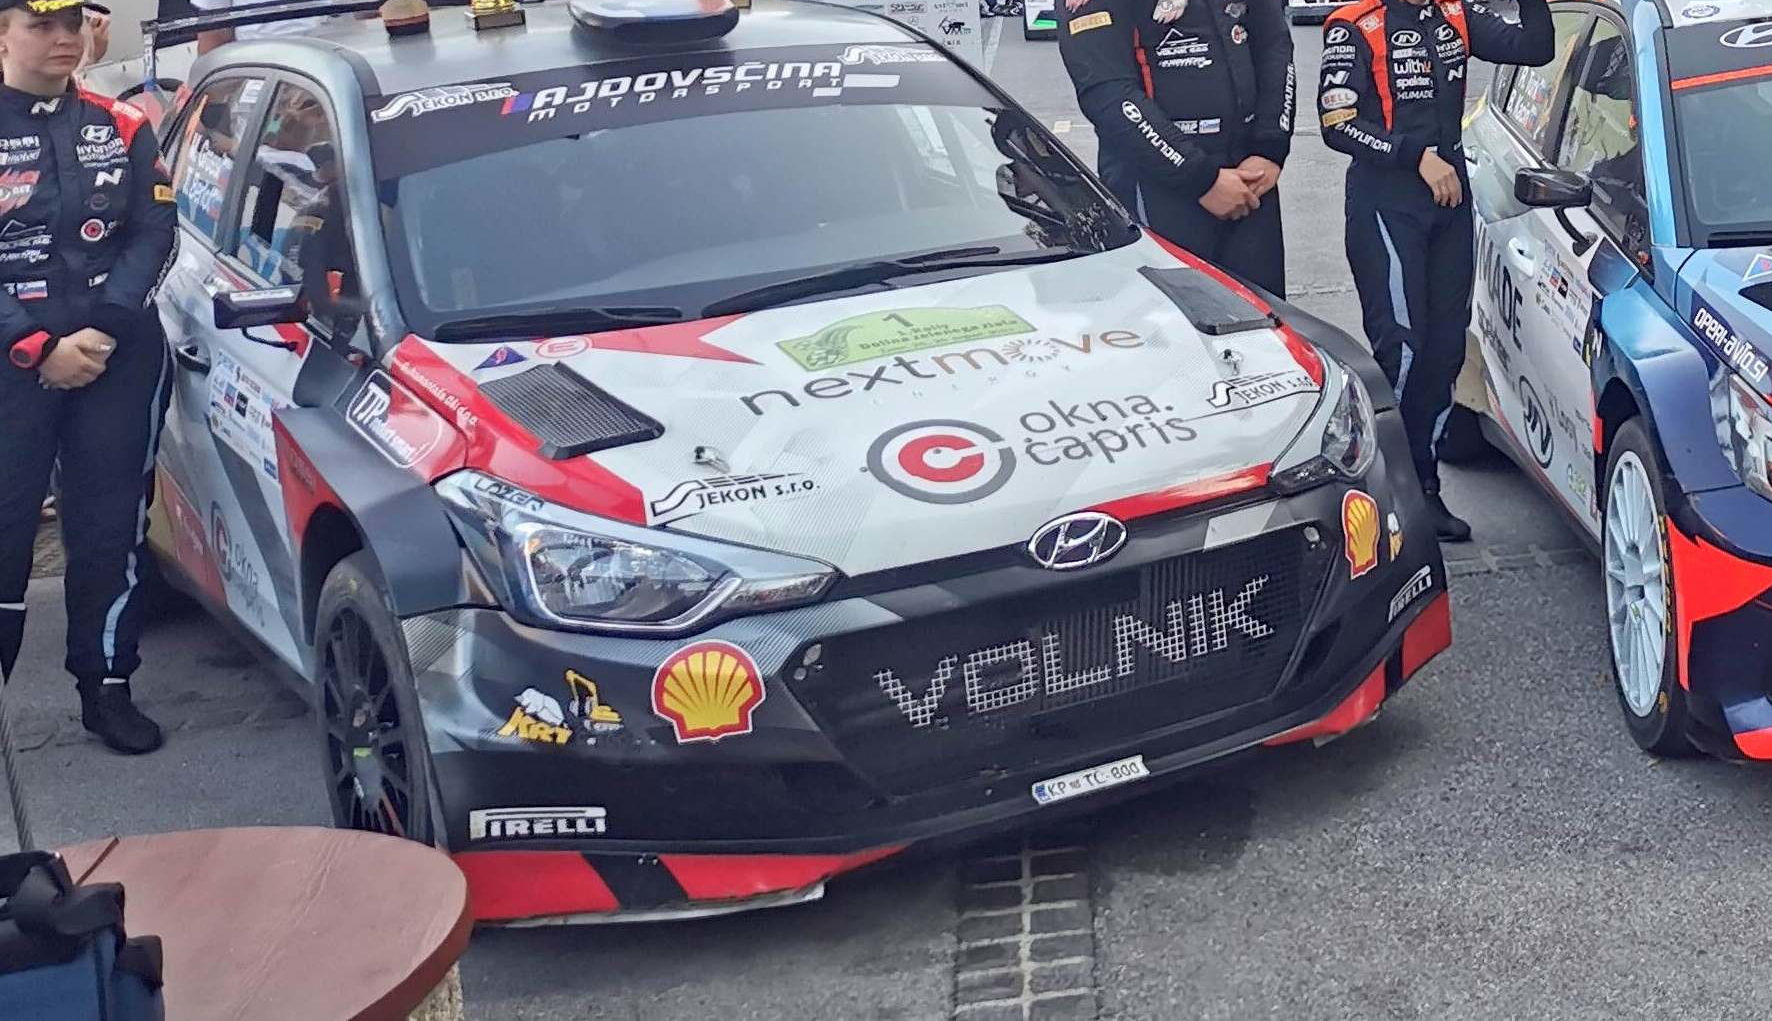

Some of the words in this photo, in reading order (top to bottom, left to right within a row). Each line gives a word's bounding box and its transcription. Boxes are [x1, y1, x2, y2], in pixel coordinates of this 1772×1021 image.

[1138, 121, 1186, 168] HYUNDAI
[699, 485, 768, 509] JEKON
[776, 481, 820, 497] s.r.o.
[1387, 564, 1433, 623] PIRELLI
[874, 574, 1276, 727] VOLNIK
[1047, 781, 1067, 798] KP
[469, 806, 607, 841] PIRELLI
